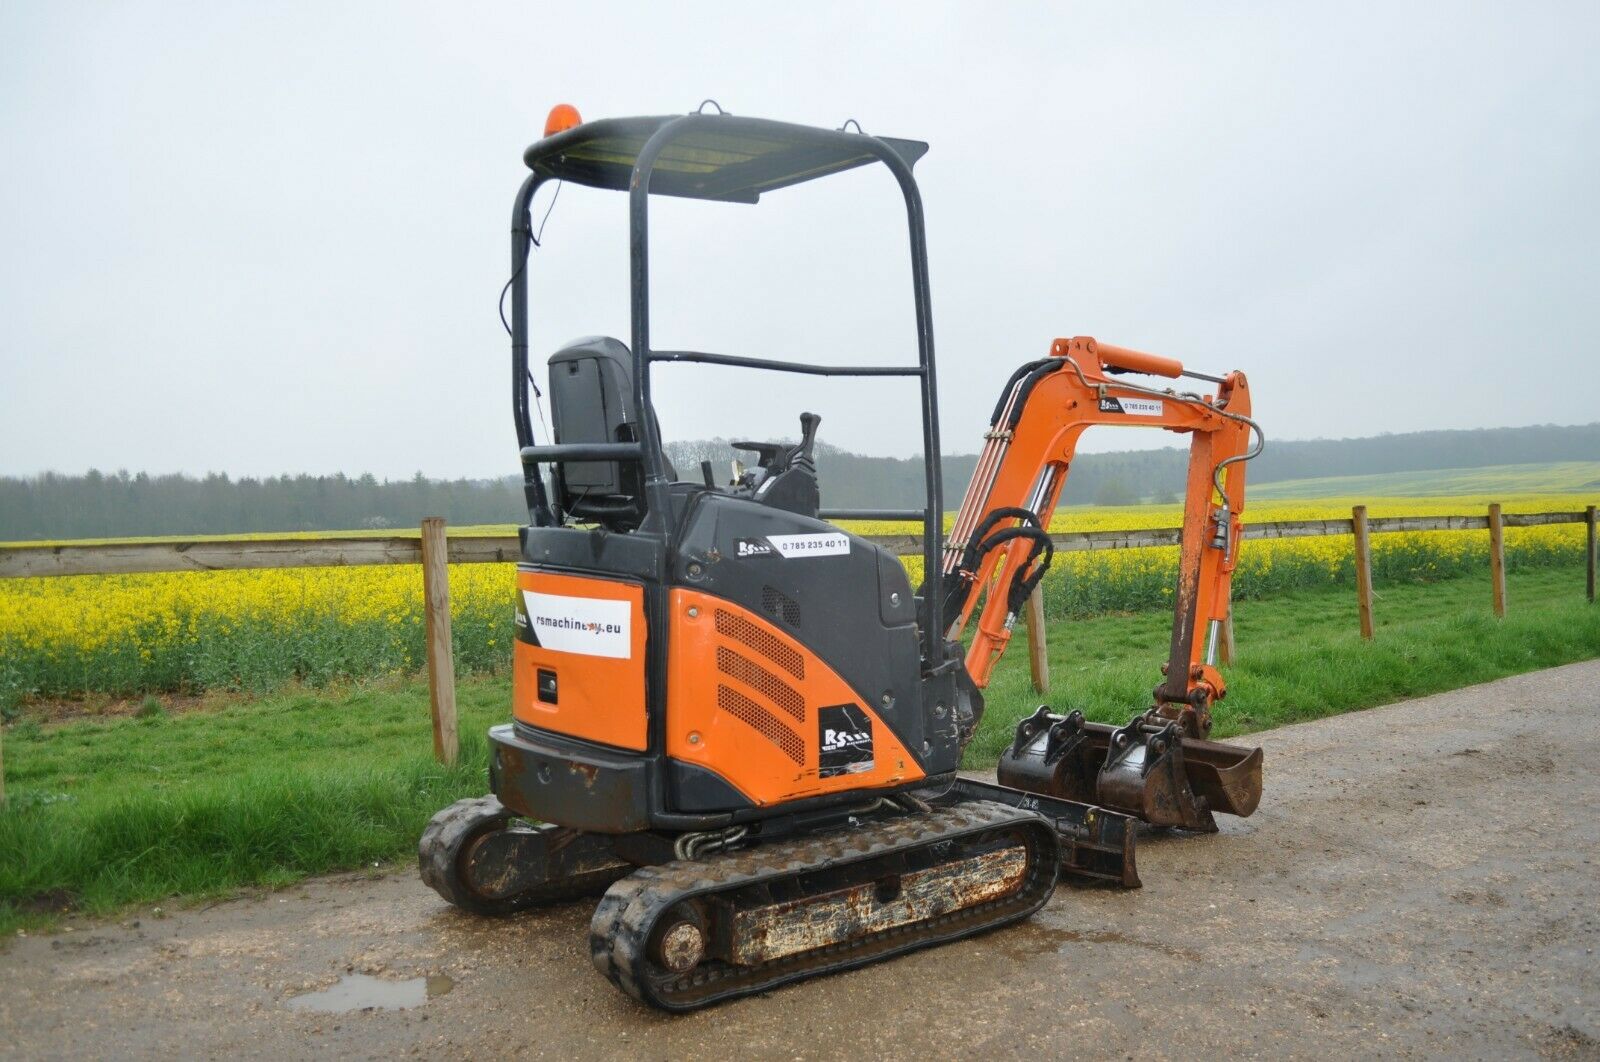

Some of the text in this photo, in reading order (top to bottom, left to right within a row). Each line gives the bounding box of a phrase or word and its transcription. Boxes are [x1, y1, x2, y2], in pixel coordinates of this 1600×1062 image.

[790, 541, 805, 550] 785
[808, 540, 823, 549] 235
[825, 540, 835, 548] 40
[838, 539, 847, 547] 11
[825, 729, 847, 748] RS
